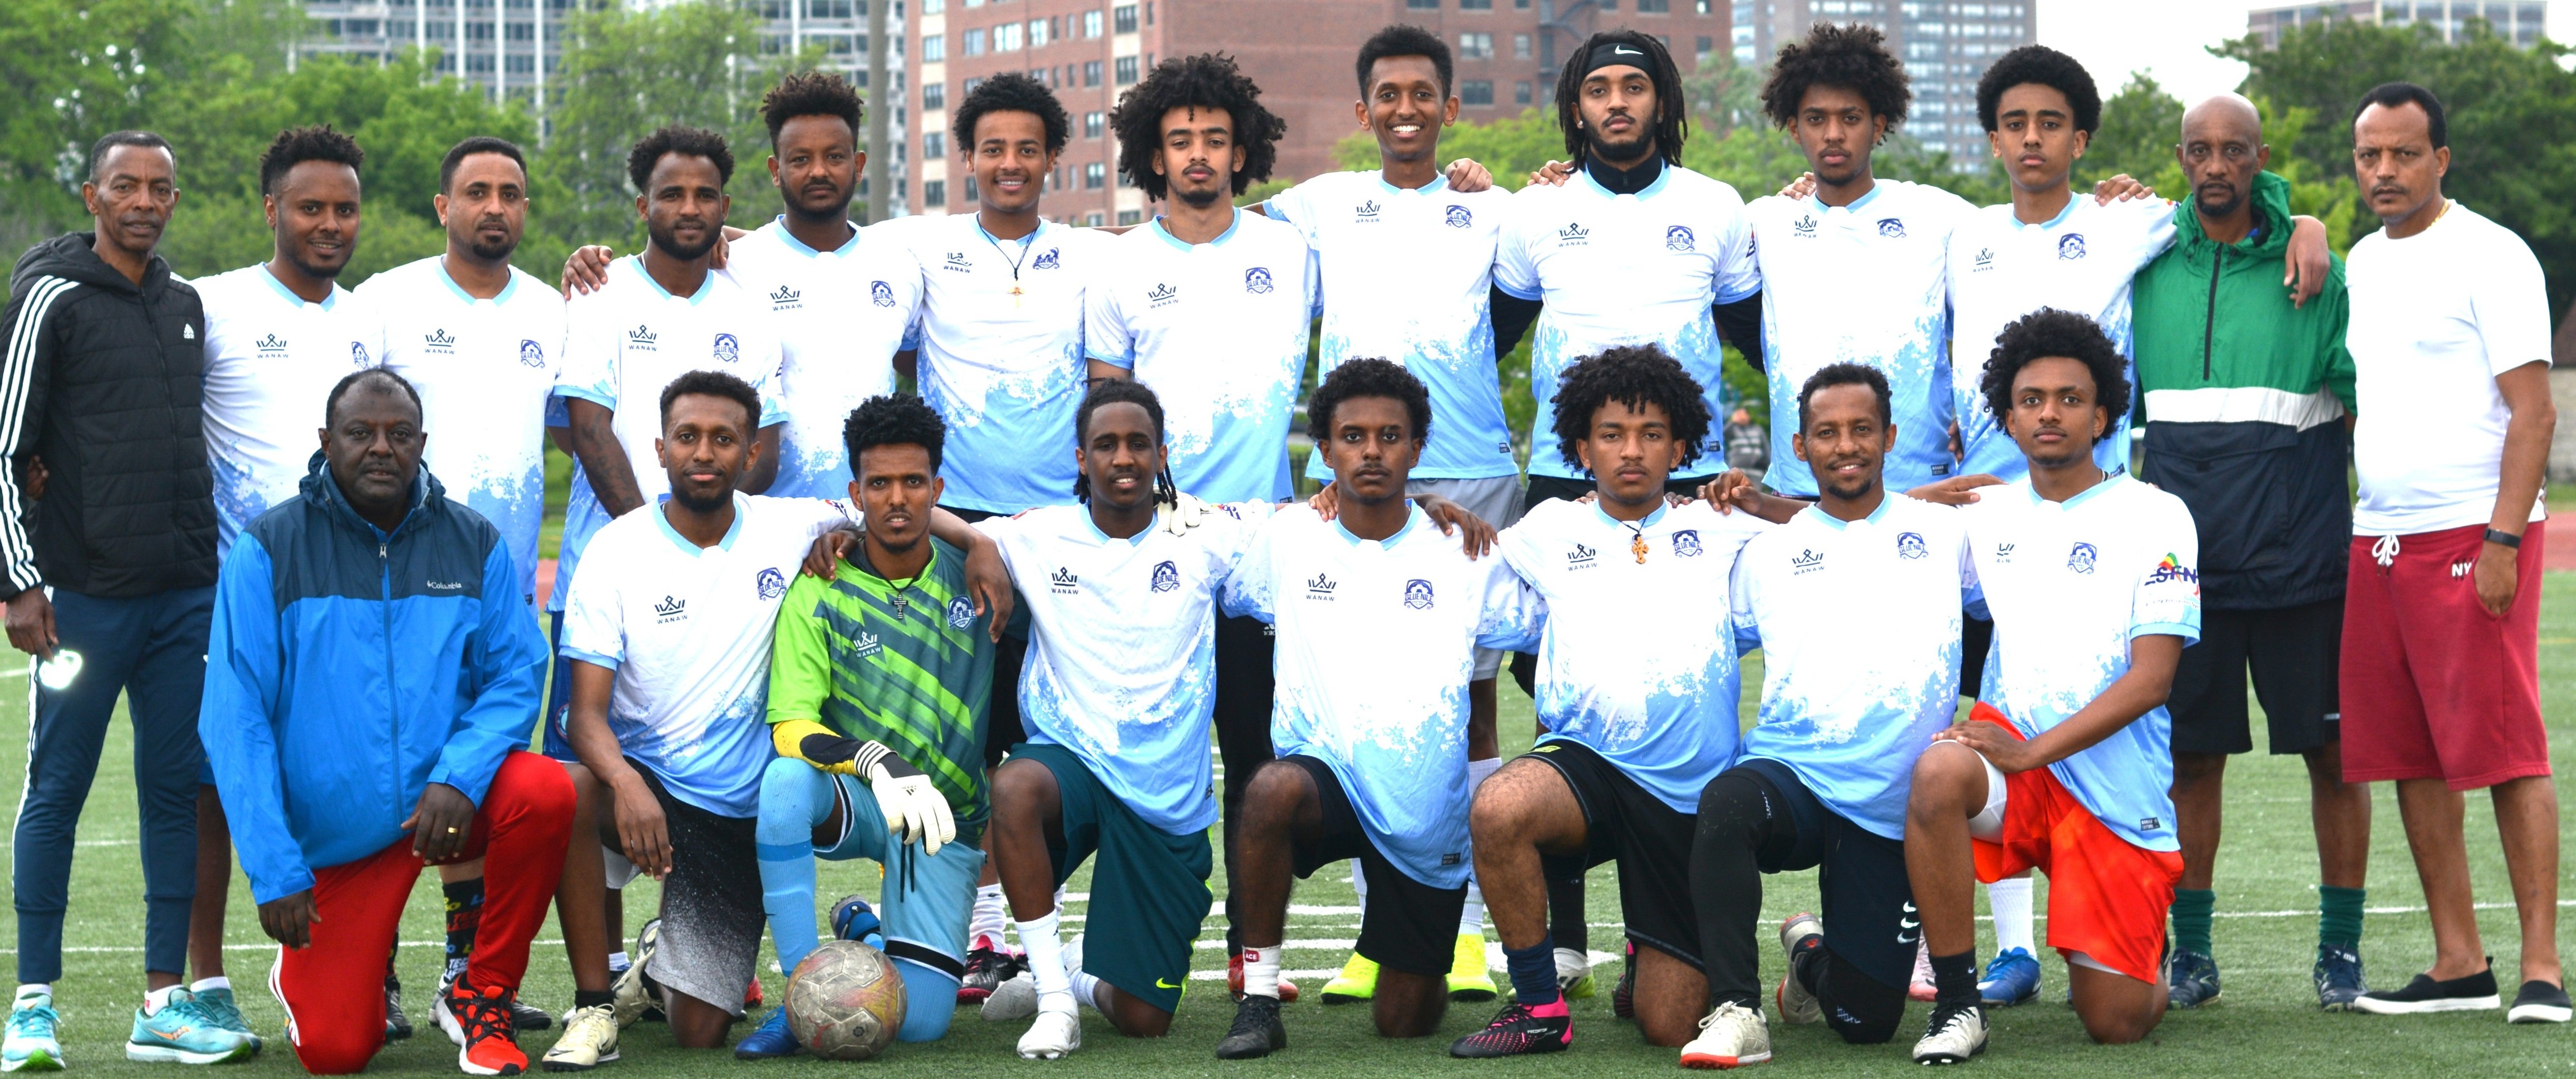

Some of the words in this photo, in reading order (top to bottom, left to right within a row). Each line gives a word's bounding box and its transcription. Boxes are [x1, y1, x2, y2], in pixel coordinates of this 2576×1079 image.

[1150, 299, 1178, 309] WANAW
[1568, 563, 1597, 571] WANAW
[1794, 566, 1824, 576] WANAW
[2452, 562, 2472, 577] NY
[1152, 575, 1164, 586] BLUE
[1165, 574, 1178, 582] NILE
[758, 581, 771, 594] BLUE
[772, 579, 785, 588] NILE
[1405, 593, 1419, 601] BLUE
[1420, 593, 1433, 603] NILE
[657, 615, 687, 624] WANAW
[949, 611, 962, 625] BLUE
[962, 609, 975, 618] NILE
[856, 647, 880, 657] WANAW
